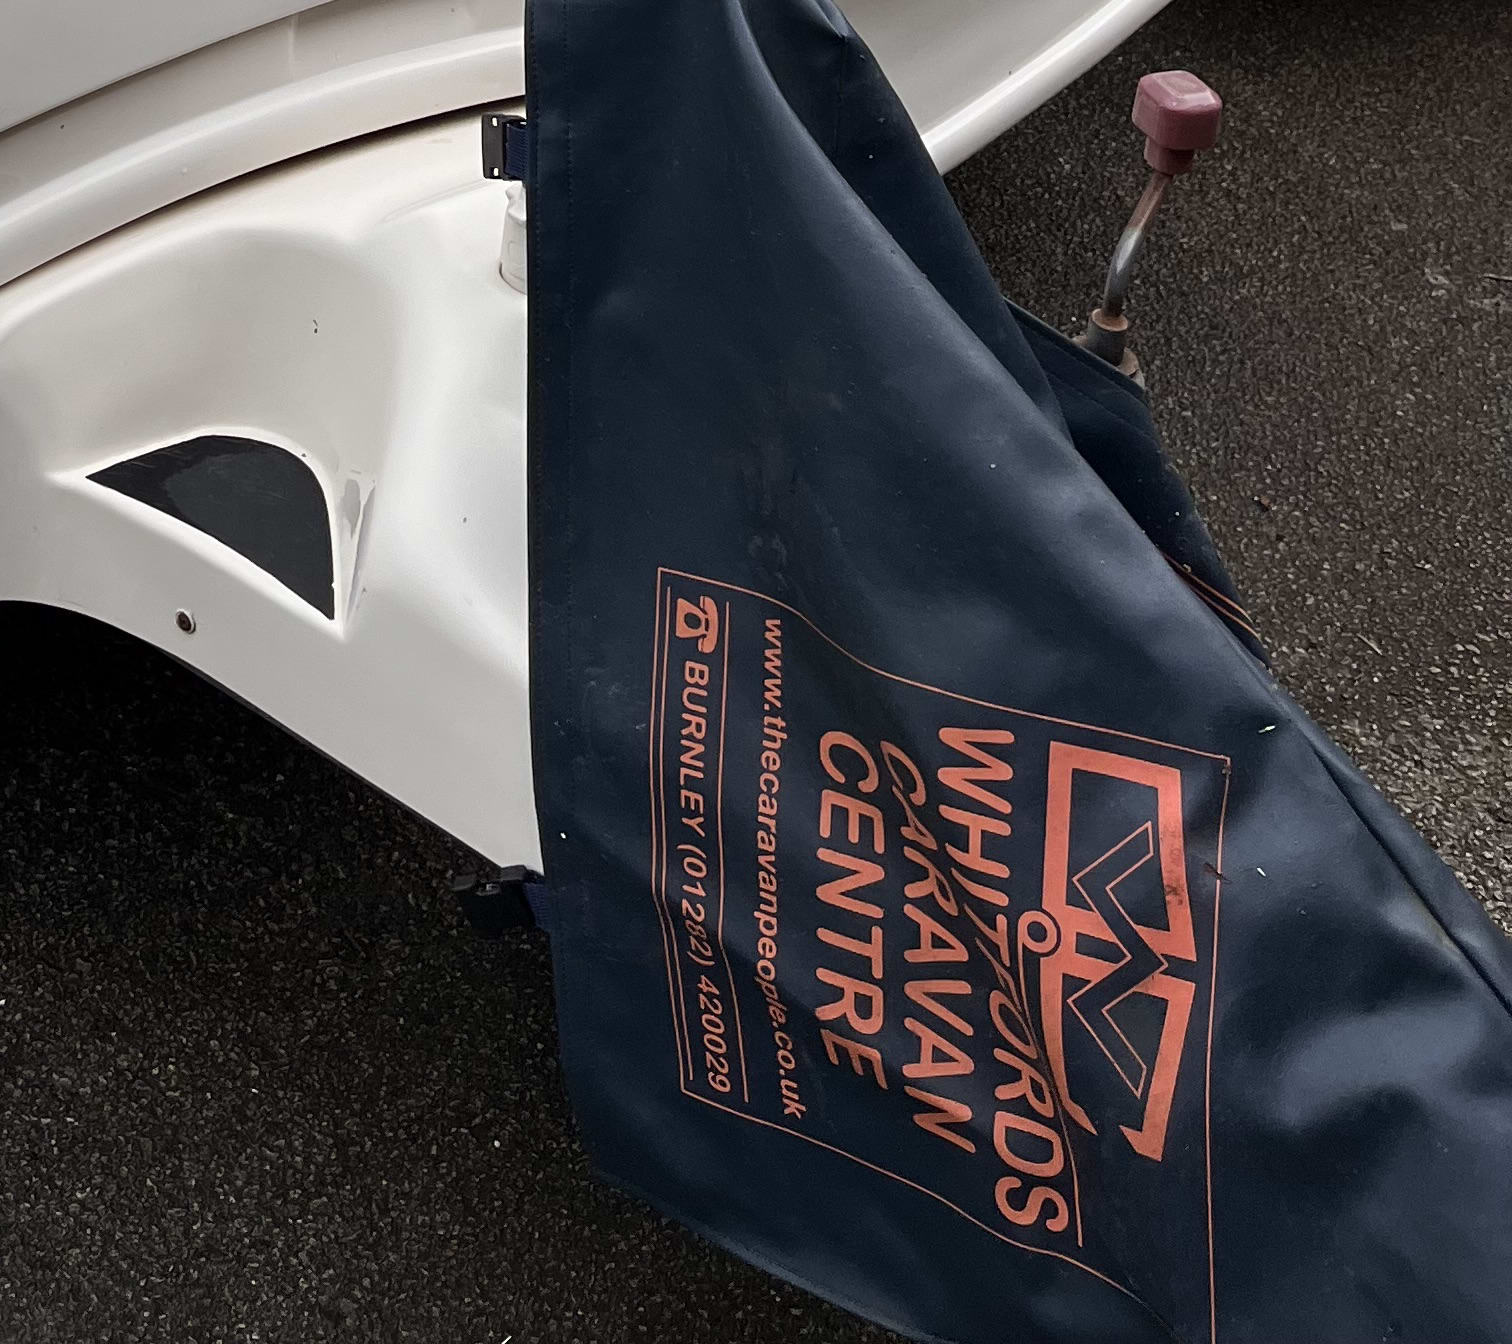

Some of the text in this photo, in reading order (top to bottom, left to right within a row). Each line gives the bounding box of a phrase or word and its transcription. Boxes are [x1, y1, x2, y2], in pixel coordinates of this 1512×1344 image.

[676, 659, 732, 1094] BURNLEY (01282) 420029
[753, 618, 807, 1120] www.thecaravanpeople.co.uk
[815, 730, 888, 1090] CENTRE
[879, 740, 976, 1154] CARAVAN
[937, 726, 1069, 1233] WHITFORDS
